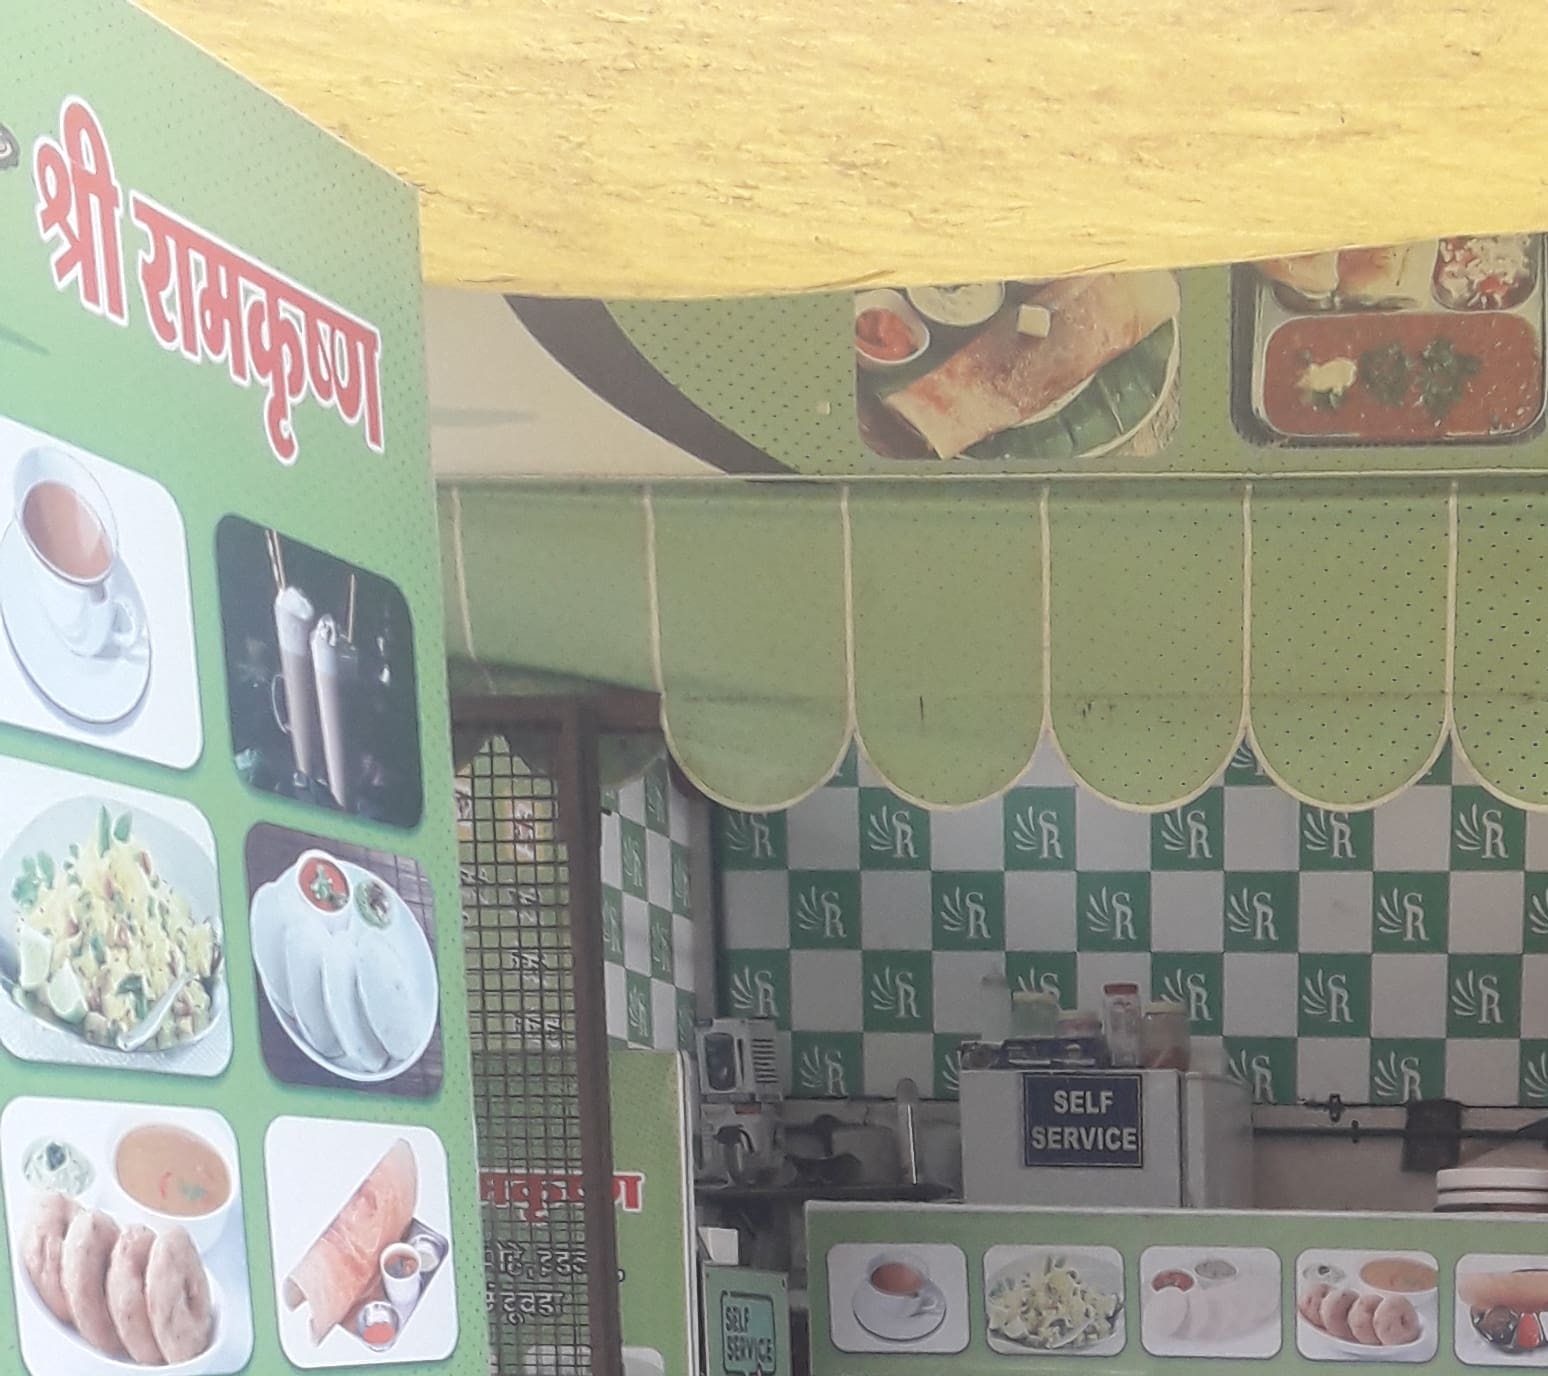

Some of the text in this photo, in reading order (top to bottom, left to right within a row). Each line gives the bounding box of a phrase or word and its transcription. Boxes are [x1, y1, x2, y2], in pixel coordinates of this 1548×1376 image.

[35, 96, 384, 465] श्री रामकृष्ण
[1054, 1090, 1113, 1114] SELF
[1031, 1126, 1137, 1150] SERVICE
[726, 1306, 749, 1332] SELF
[727, 1336, 772, 1362] SERVICE
